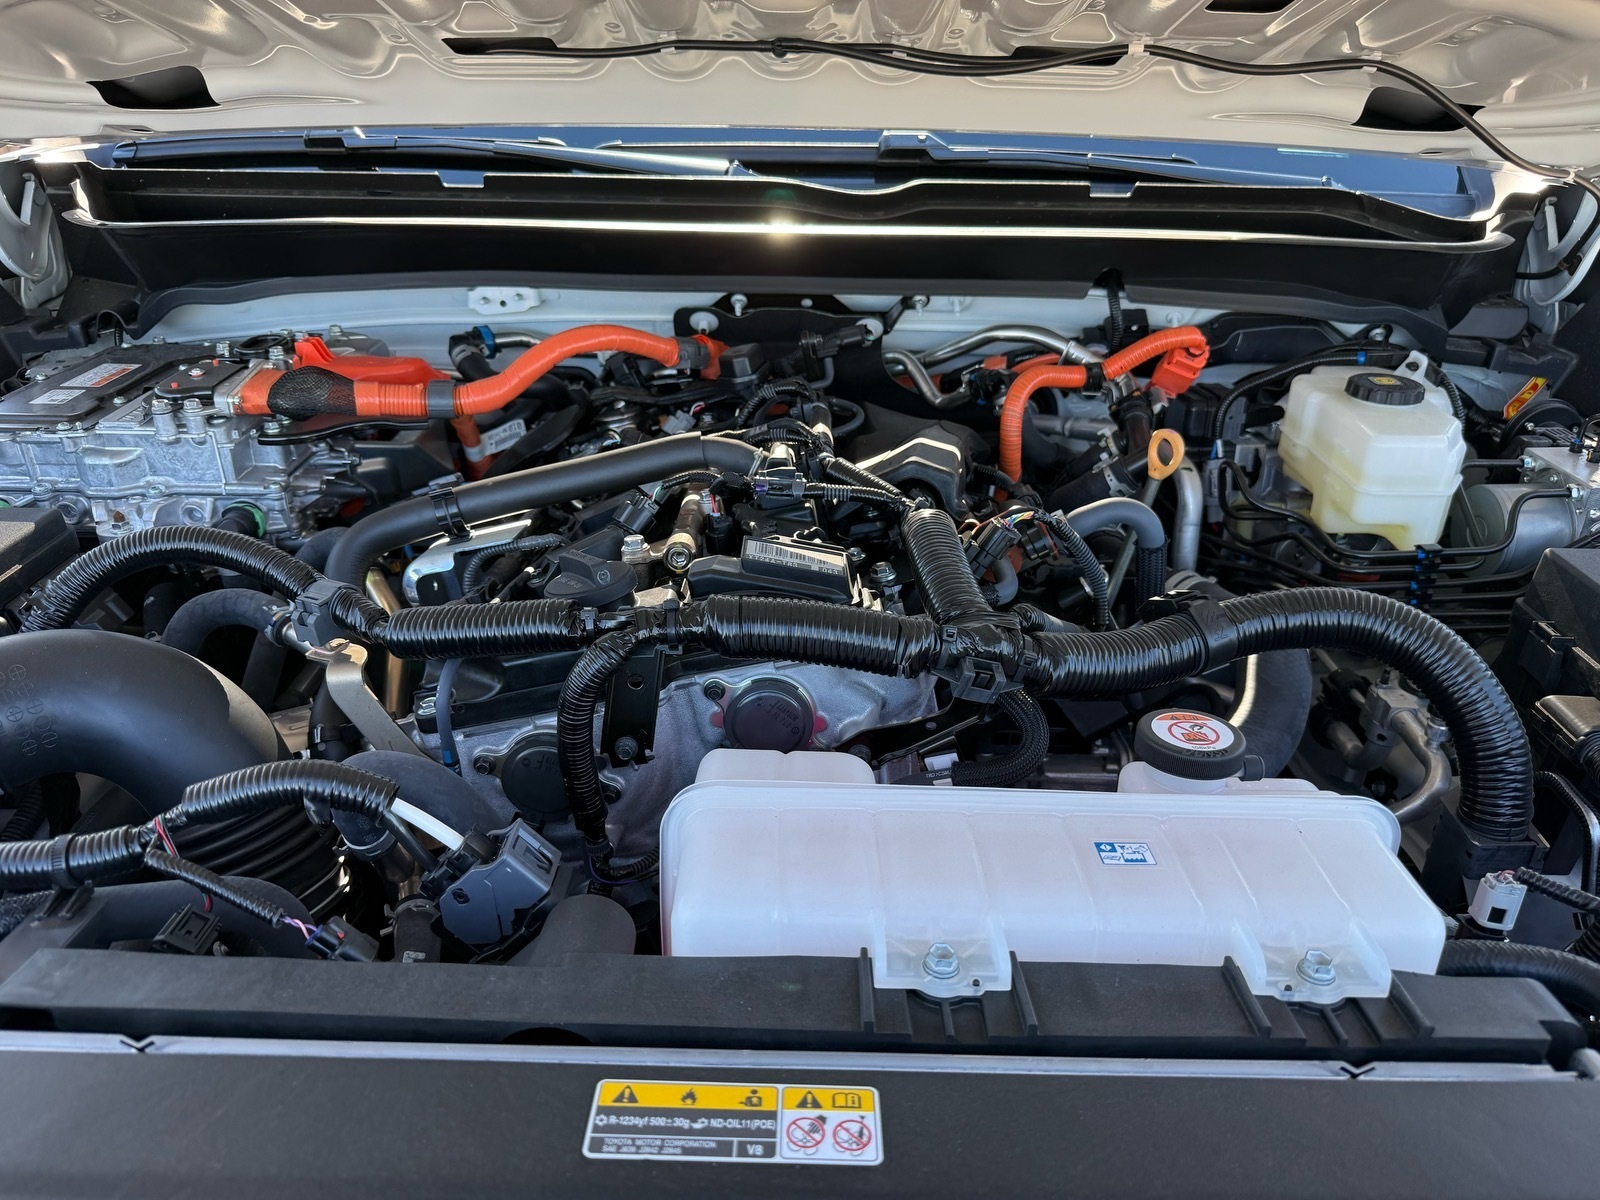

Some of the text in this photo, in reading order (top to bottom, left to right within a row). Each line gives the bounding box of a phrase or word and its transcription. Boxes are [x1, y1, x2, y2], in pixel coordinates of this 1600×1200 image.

[608, 1115, 648, 1127] R-1234yf
[635, 1138, 661, 1146] MOTOR
[664, 1140, 717, 1148] CORPORATION
